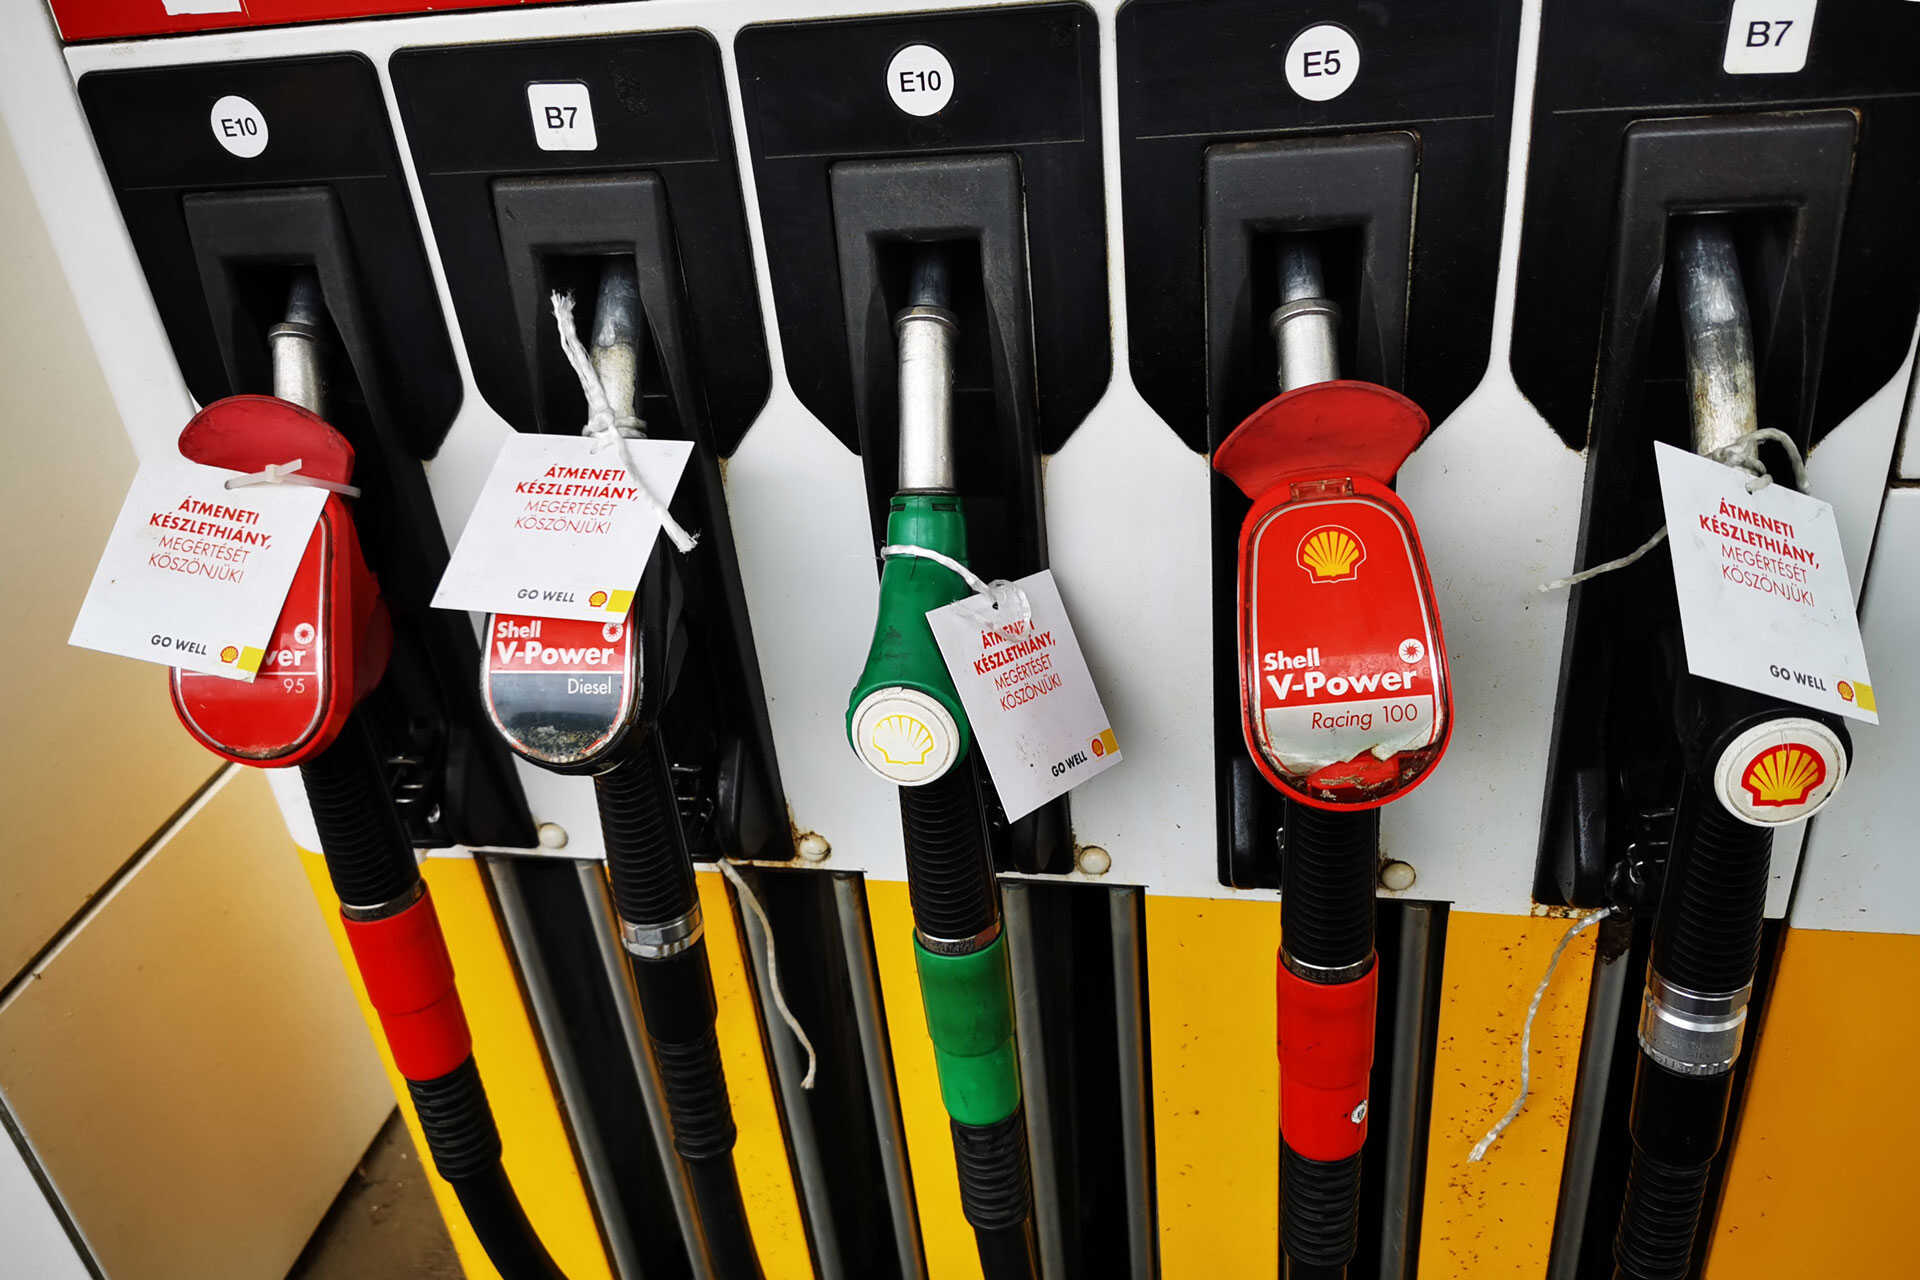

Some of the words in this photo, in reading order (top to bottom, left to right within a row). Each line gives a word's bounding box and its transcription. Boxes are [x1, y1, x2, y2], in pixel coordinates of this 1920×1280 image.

[1746, 20, 1793, 48] B7
[1302, 50, 1341, 77] E5
[899, 70, 941, 93] E10
[221, 116, 257, 138] E10
[547, 106, 578, 130] B7
[544, 463, 626, 482] ÁTMENETI
[515, 480, 639, 502] KÉSZLETHIÁNY,
[178, 495, 260, 525] ÁTMENETI
[524, 500, 617, 517] MEGÉRTÉSÉT
[1719, 497, 1795, 540] ÁTMENETI
[149, 512, 272, 550] KÉSZLETHIÁNY,
[514, 516, 612, 534] KÖSZÖNJÜK!
[158, 535, 250, 564] MEGÉRTÉSÉT
[1699, 514, 1822, 570] KÉSZLETHIÁNY,
[148, 553, 244, 584] KÖSZÖNJÜK!
[1721, 543, 1809, 585] MEGÉRTÉSÉT
[517, 589, 539, 601] GO
[543, 590, 575, 603] WELL
[1722, 563, 1815, 608] KÖSZÖNJÜK!
[497, 621, 541, 639] Shell
[151, 634, 172, 649] GO
[175, 638, 207, 656] WELL
[496, 641, 615, 665] V-Power
[973, 631, 1056, 675] KÉSZLETHIÁNY,
[994, 653, 1054, 691] MEGÉRTÉSÉT
[1264, 648, 1320, 671] Shell
[283, 678, 305, 694] 95
[568, 678, 612, 695] Diesel
[1266, 669, 1417, 701] V-Power
[1769, 664, 1791, 682] GO
[1793, 671, 1827, 692] WELL
[999, 674, 1063, 712] KÖSZÖNJÜK!
[1311, 709, 1373, 731] Racing
[1383, 703, 1418, 723] 100
[1051, 762, 1067, 778] GO
[1066, 750, 1088, 772] WELL
